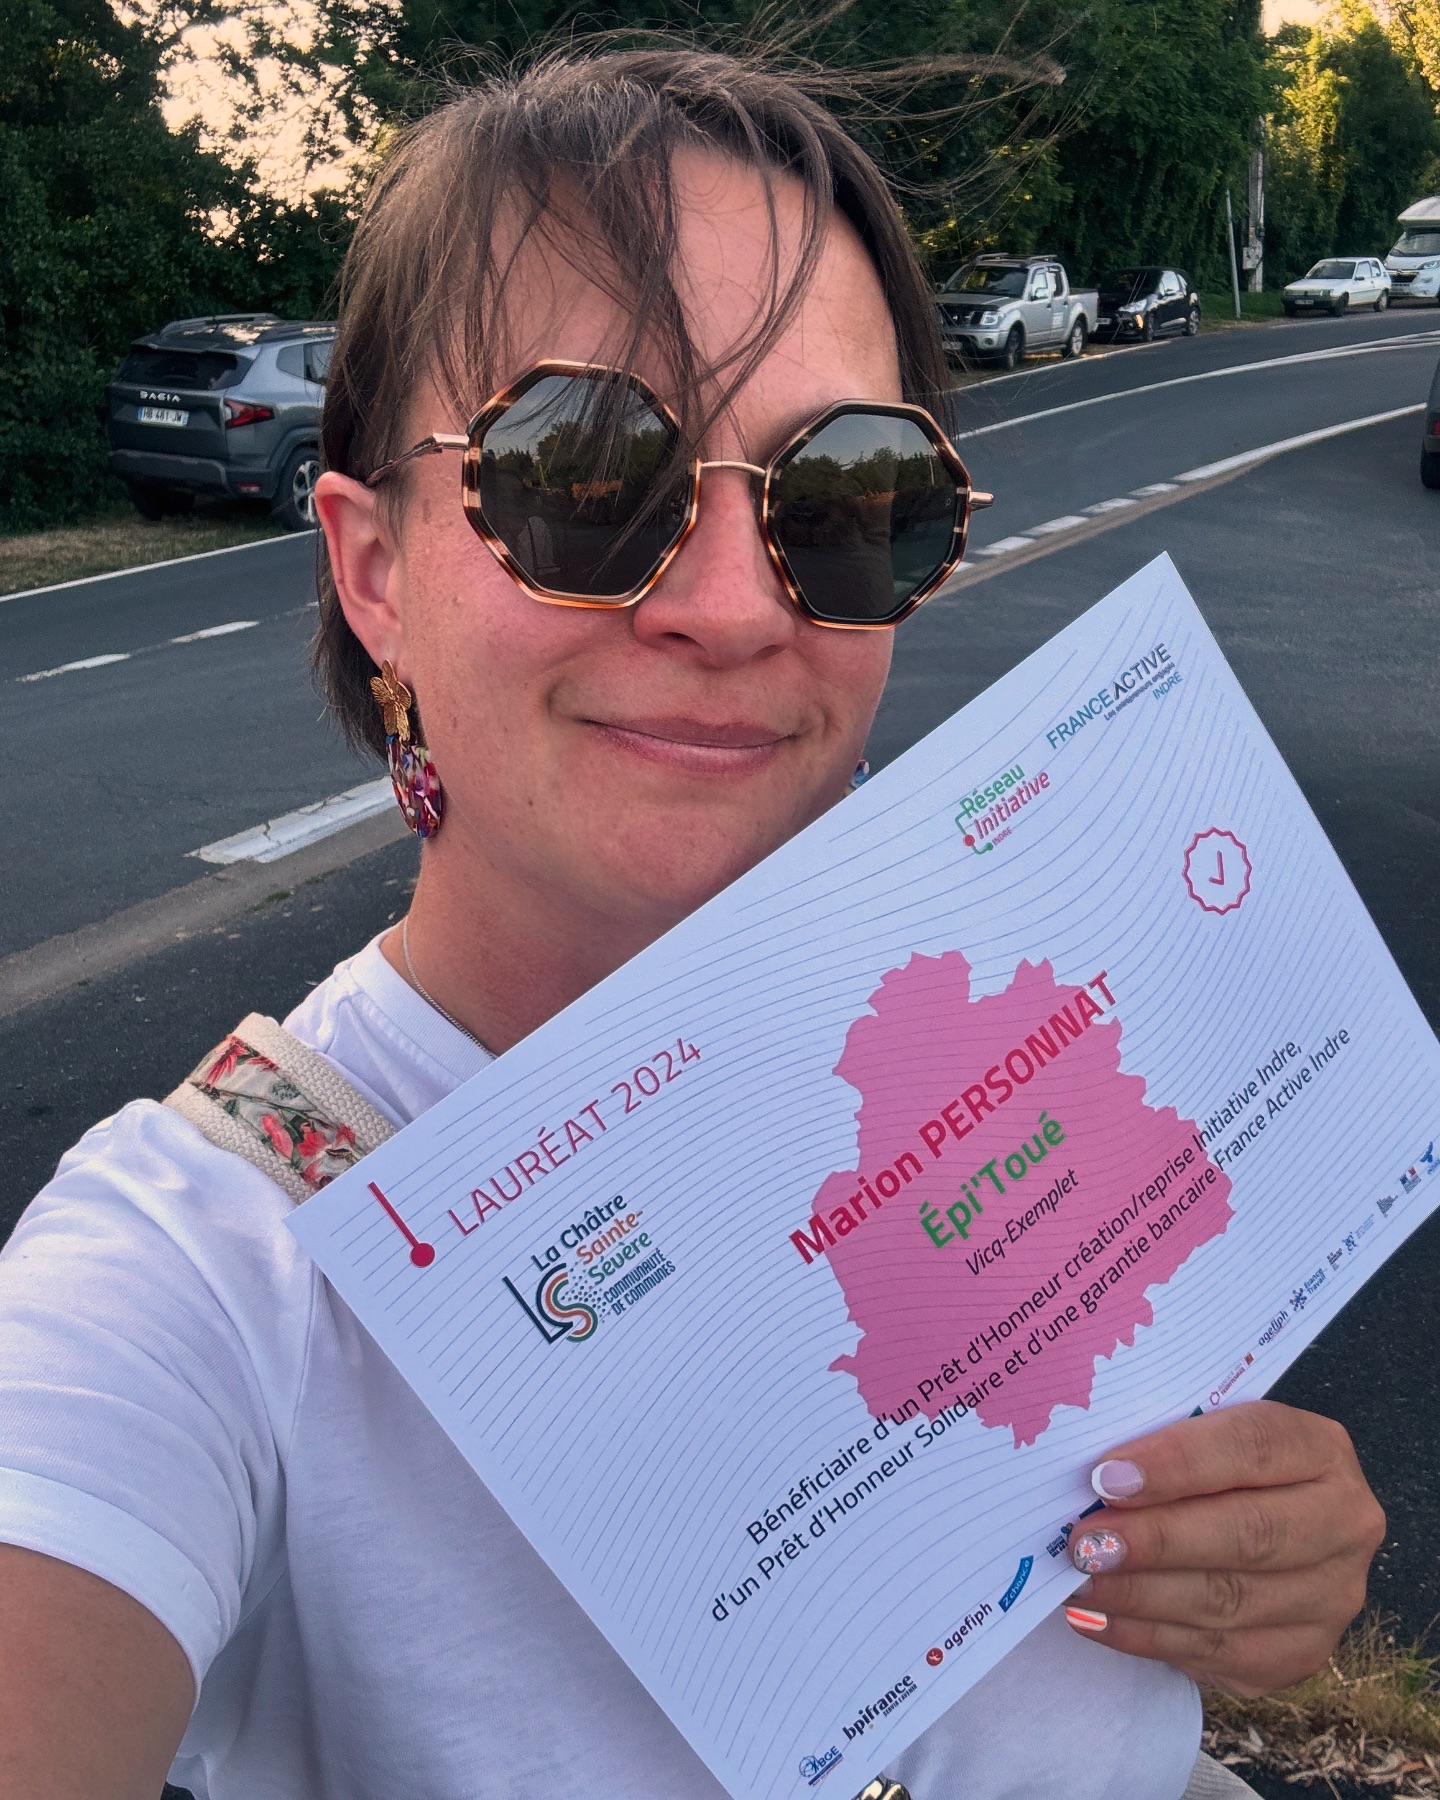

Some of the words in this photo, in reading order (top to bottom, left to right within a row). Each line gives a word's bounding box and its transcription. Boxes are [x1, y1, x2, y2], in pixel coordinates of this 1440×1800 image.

[140, 390, 181, 402] DACIA
[1152, 672, 1183, 700] INDRE
[959, 764, 1025, 819] Réseau
[974, 771, 1050, 839] Initiative
[992, 826, 1013, 847] INDRE
[447, 1099, 607, 1236] LAURÉAT
[611, 1038, 701, 1114] 2024
[789, 1150, 924, 1265] Marion
[918, 970, 1117, 1159] PERSONNAT
[919, 1110, 1066, 1249] Épi'Toué
[531, 1245, 561, 1272] La
[560, 1194, 628, 1249] Châtre
[576, 1210, 644, 1265] Sainte-
[965, 1169, 1080, 1276] Vicq-Exemplet
[588, 1232, 653, 1285] Sévère
[604, 1247, 667, 1304] COMMUNAUTÉ
[611, 1300, 627, 1316] DE
[624, 1260, 676, 1308] COMMUNES
[746, 1437, 873, 1545] Bénéficiaire
[872, 1399, 920, 1441] d'un
[917, 1360, 968, 1402] Prêt
[966, 1273, 1063, 1365] d'Honneur
[1064, 1147, 1196, 1279] création/reprise
[1192, 1080, 1259, 1149] Initiative
[1255, 1040, 1302, 1087] Indre,
[712, 1576, 761, 1622] d'un
[757, 1533, 810, 1582] Prêt
[809, 1440, 914, 1539] d'Honneur
[914, 1369, 1004, 1448] Solidaire
[1004, 1349, 1028, 1375] et
[1027, 1305, 1080, 1356] d'une
[1080, 1236, 1151, 1314] garantie
[1147, 1167, 1217, 1241] bancaire
[1213, 1116, 1267, 1172] France
[1267, 1065, 1312, 1120] Active
[1310, 1028, 1351, 1072] Indre
[1258, 1310, 1289, 1347] agefiph
[944, 1602, 993, 1650] agefiph
[842, 1675, 914, 1741] bpifrance
[818, 1745, 840, 1768] BGE
